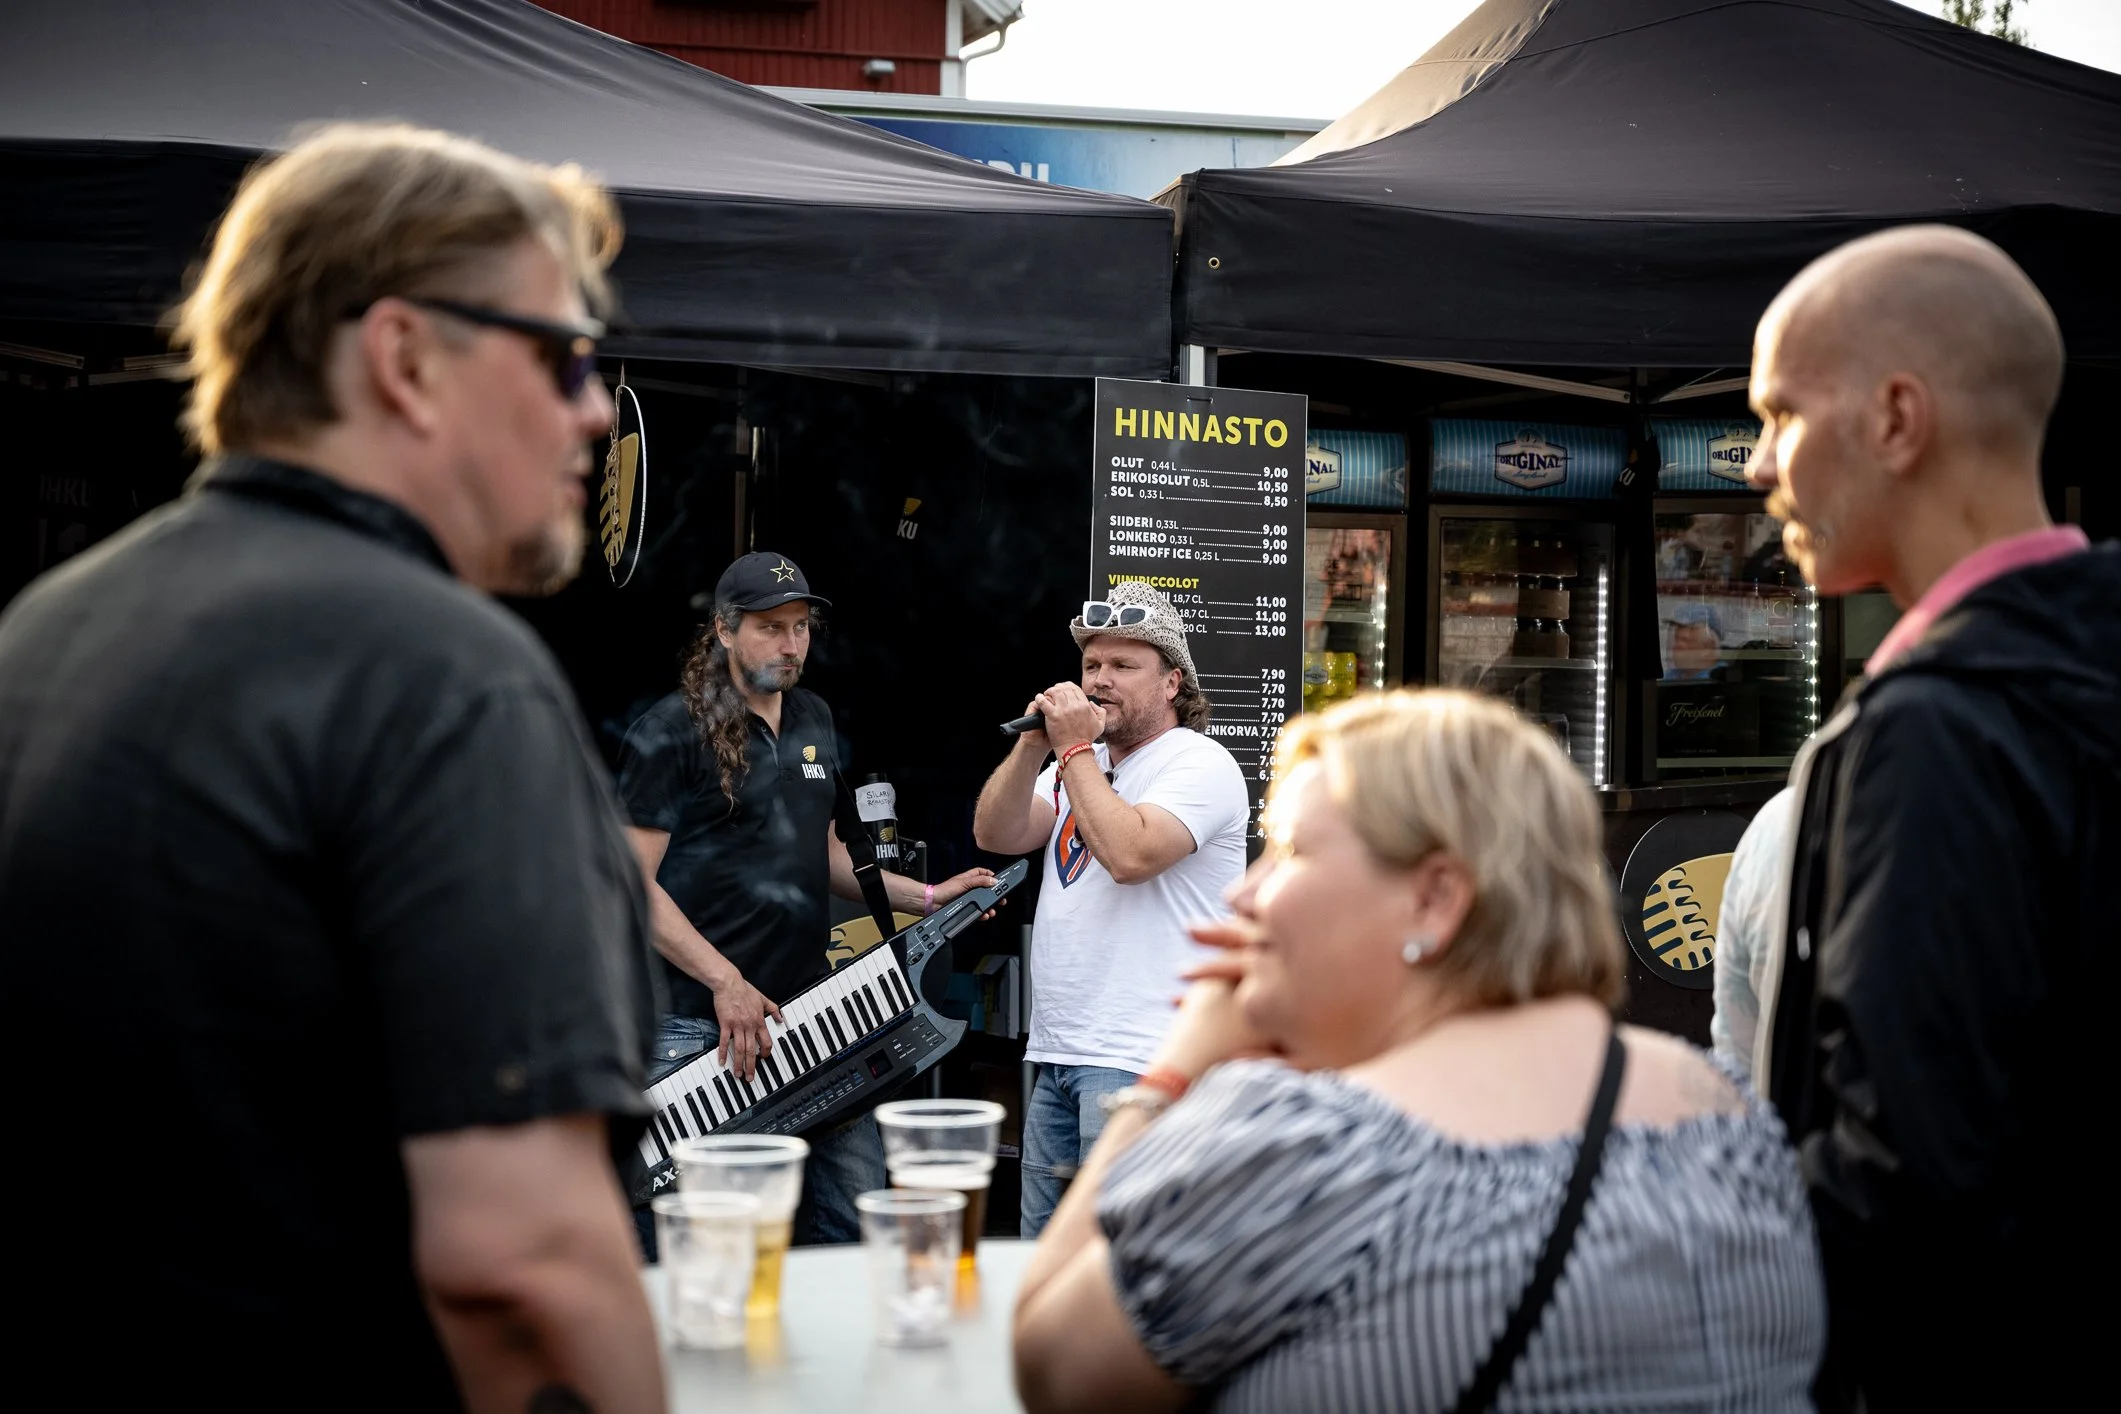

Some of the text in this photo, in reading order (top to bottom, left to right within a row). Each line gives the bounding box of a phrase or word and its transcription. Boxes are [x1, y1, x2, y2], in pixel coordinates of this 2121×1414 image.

[1115, 407, 1289, 448] HINNASTO
[1111, 456, 1288, 479] OLUT 0,44 L 9,00
[1306, 459, 1335, 475] NAL
[1499, 452, 1562, 471] ORIGINAL
[1111, 471, 1288, 493] ERIKOISOLUT 0,5L 10,50
[1110, 486, 1288, 508] SOL 0,33 L 8,50
[1109, 515, 1288, 536] SIIDERI 0,33L 9,00
[1109, 530, 1288, 551] LONKERO 0,33 L 9,00
[1109, 545, 1287, 565] SMIRNOFF ICE 0,25 L 9,00
[1173, 593, 1190, 604] 18,7
[1192, 594, 1204, 604] CL
[1255, 596, 1287, 608] 11,00
[1179, 609, 1287, 623] 18,7 CL 11,00
[1196, 625, 1207, 634] CL
[1255, 625, 1286, 637] 13,00
[1261, 669, 1286, 680] 7,90
[1261, 683, 1285, 695] 7,70
[1261, 697, 1285, 709] 7,70
[1261, 712, 1285, 724] 7,70
[1665, 701, 1726, 727] Freixenet
[1260, 726, 1284, 738] 7,70
[1260, 741, 1278, 753] 7,7
[1260, 755, 1277, 767] 7,0
[801, 763, 826, 780] IHKU
[1259, 769, 1277, 782] 6,5
[876, 843, 900, 859] IHKU
